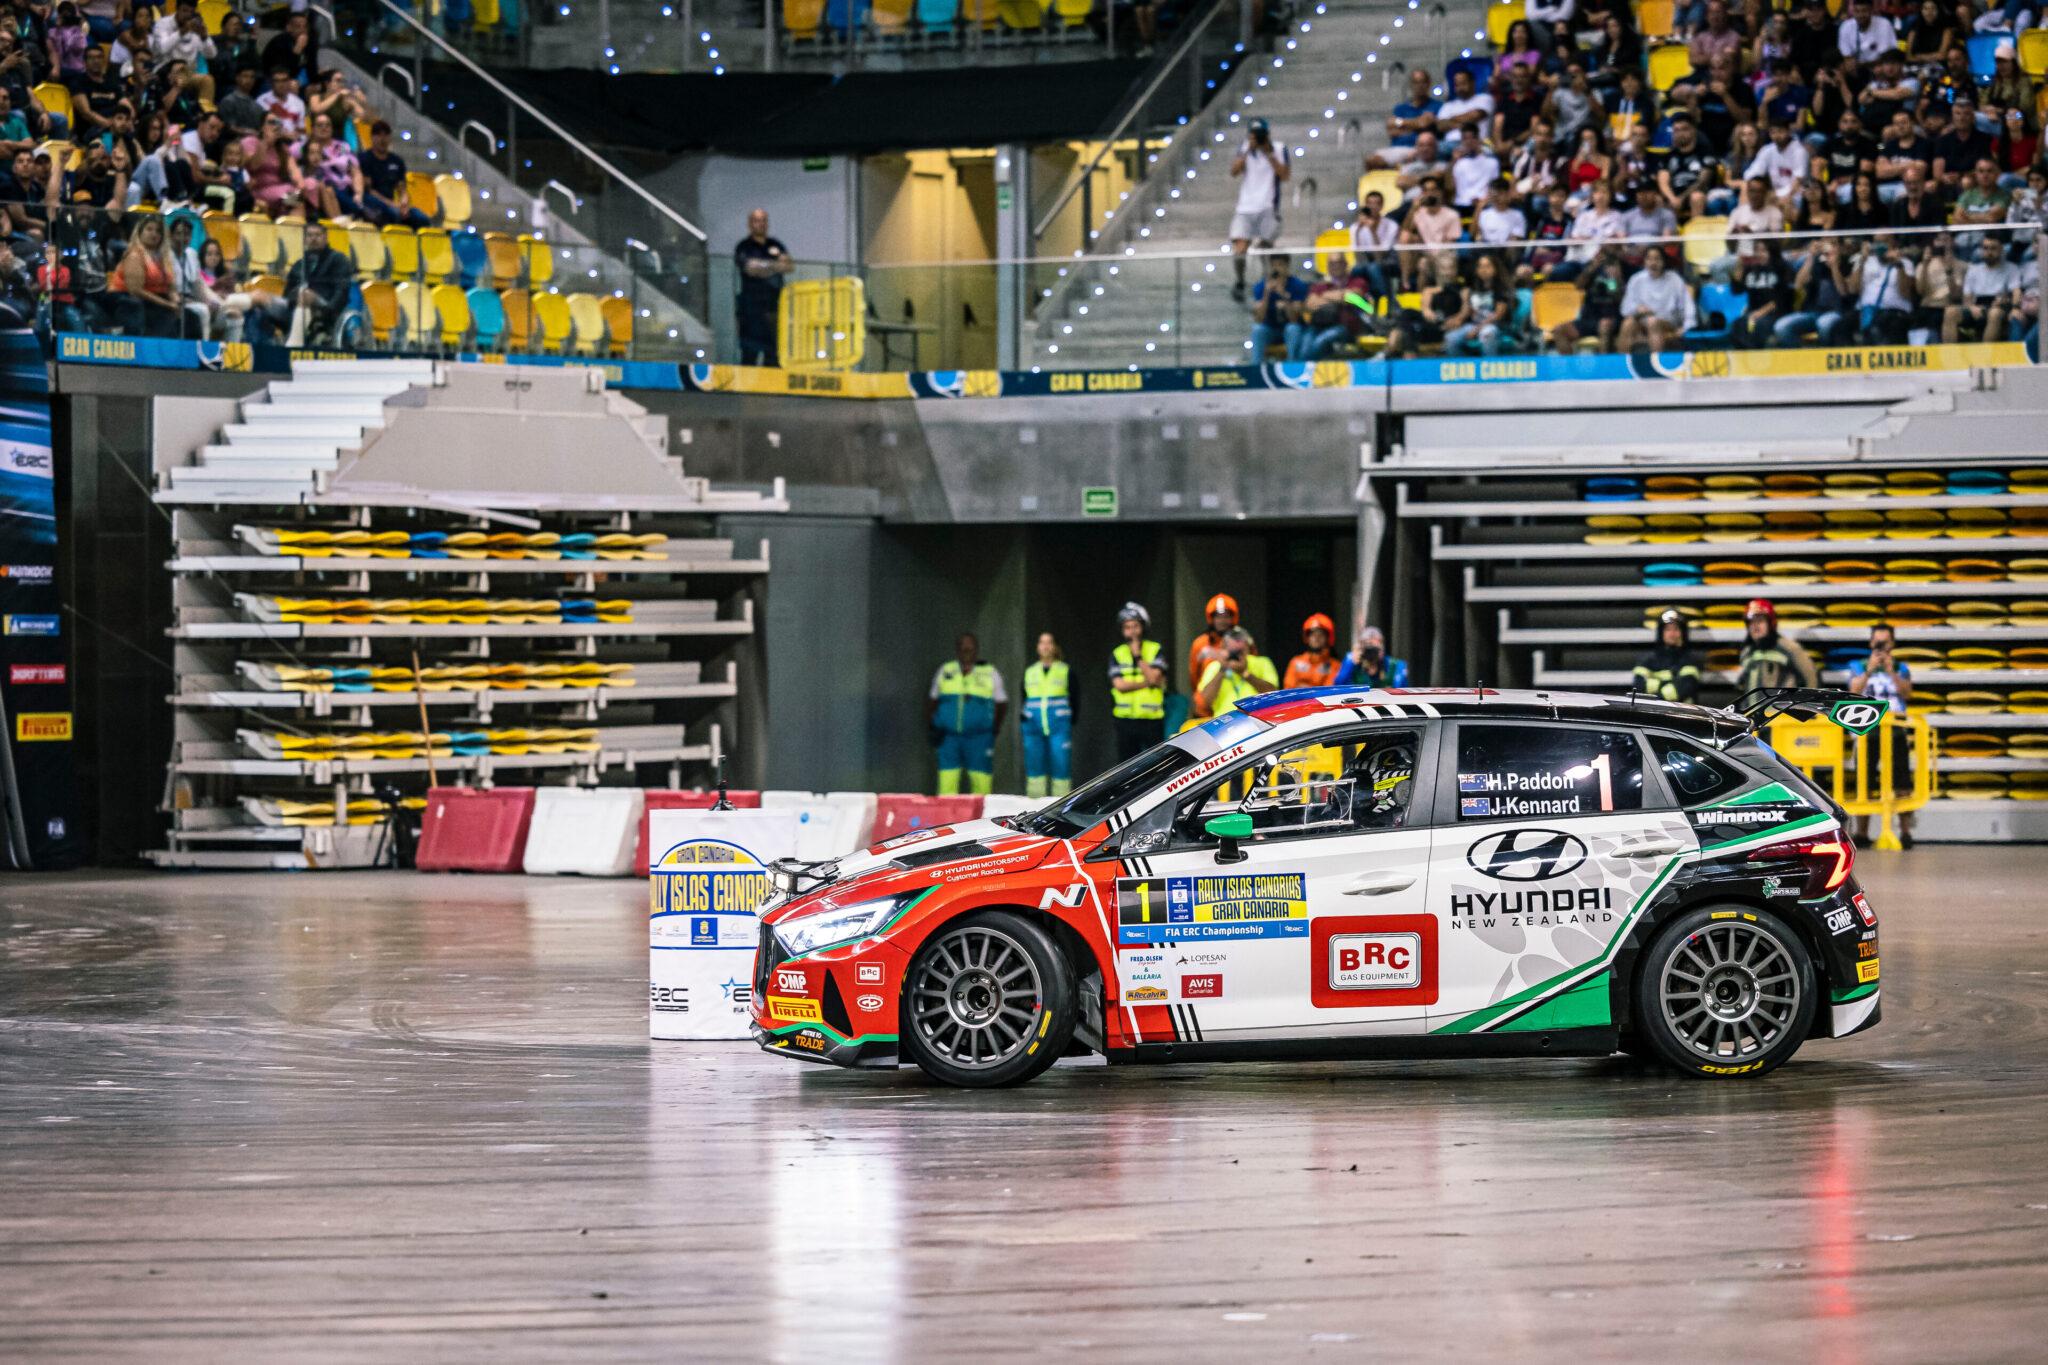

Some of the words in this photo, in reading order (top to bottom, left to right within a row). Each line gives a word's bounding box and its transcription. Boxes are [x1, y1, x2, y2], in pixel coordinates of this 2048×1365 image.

[63, 337, 90, 357] GRAN
[93, 339, 135, 360] CANARIA
[1440, 362, 1476, 381] GRAN
[1481, 360, 1538, 379] CANARIA
[1827, 352, 1862, 371] GRAN
[1869, 350, 1927, 368] CANARIA
[1050, 374, 1085, 392] GRAN
[1088, 372, 1142, 390] CANARIA
[1166, 745, 1246, 793] www.brc.it
[1488, 772, 1574, 791] H.Paddon
[1590, 753, 1614, 811] 1
[1490, 795, 1580, 815] J.Kennard
[677, 847, 696, 863] GRAN
[699, 845, 735, 863] CANARIA
[945, 863, 981, 875] HYUNDAI
[981, 854, 1030, 868] MOTORSPORT
[946, 870, 980, 882] Customer
[981, 867, 1005, 878] Racing
[670, 874, 709, 912] ISLAS
[1197, 878, 1224, 903] RALLY
[1226, 877, 1252, 901] ISLAS
[1255, 875, 1301, 900] CANARIAS
[1136, 882, 1151, 923] 1
[1212, 902, 1241, 920] GRAN
[1243, 901, 1290, 919] CANARIA
[1451, 887, 1612, 917] HYUNDAI
[1452, 918, 1497, 930] NEW
[1512, 913, 1613, 926] ZEALAND
[1827, 910, 1853, 931] OMP
[1165, 928, 1181, 937] FIA
[1182, 927, 1200, 936] ERC
[1202, 926, 1264, 938] Championship
[1190, 954, 1227, 962] LOPESAN
[1339, 942, 1411, 971] BRC
[778, 974, 807, 990] OMP
[1189, 978, 1214, 988] AVIS
[1340, 973, 1358, 981] GAS
[1360, 972, 1410, 981] EQUIPMENT
[772, 1001, 817, 1018] PIRELLI
[795, 1035, 825, 1051] TRADE
